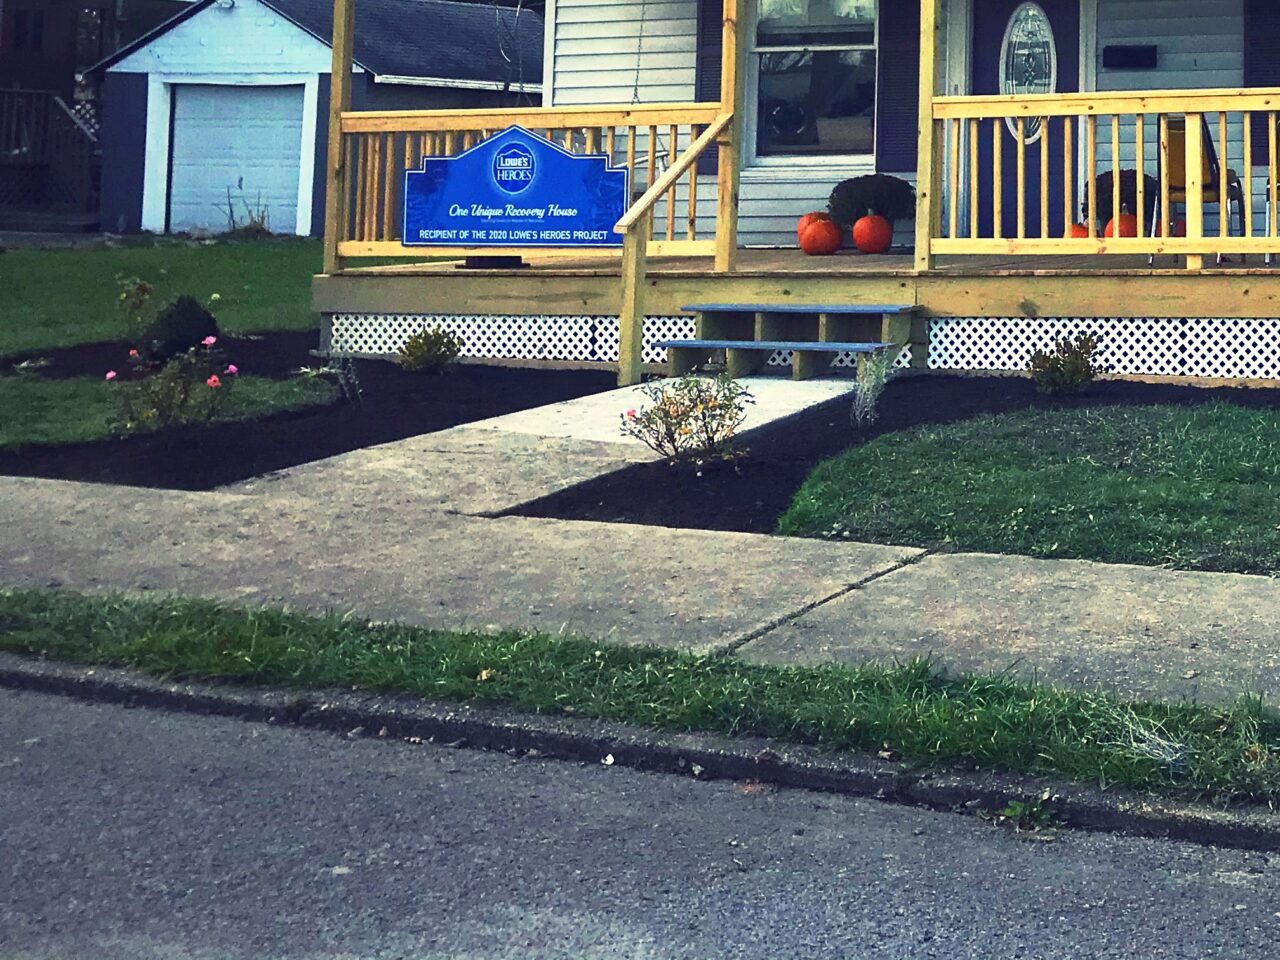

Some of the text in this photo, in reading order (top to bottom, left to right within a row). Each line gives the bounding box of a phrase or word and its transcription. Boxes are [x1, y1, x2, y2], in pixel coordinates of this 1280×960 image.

[500, 155, 529, 167] LOWE'S
[497, 169, 532, 181] HEROES
[449, 203, 577, 220] One Unique Recovery House
[419, 230, 608, 240] RECIPIENT OF THE 2020 LOWE'S HEROES PROJECT
